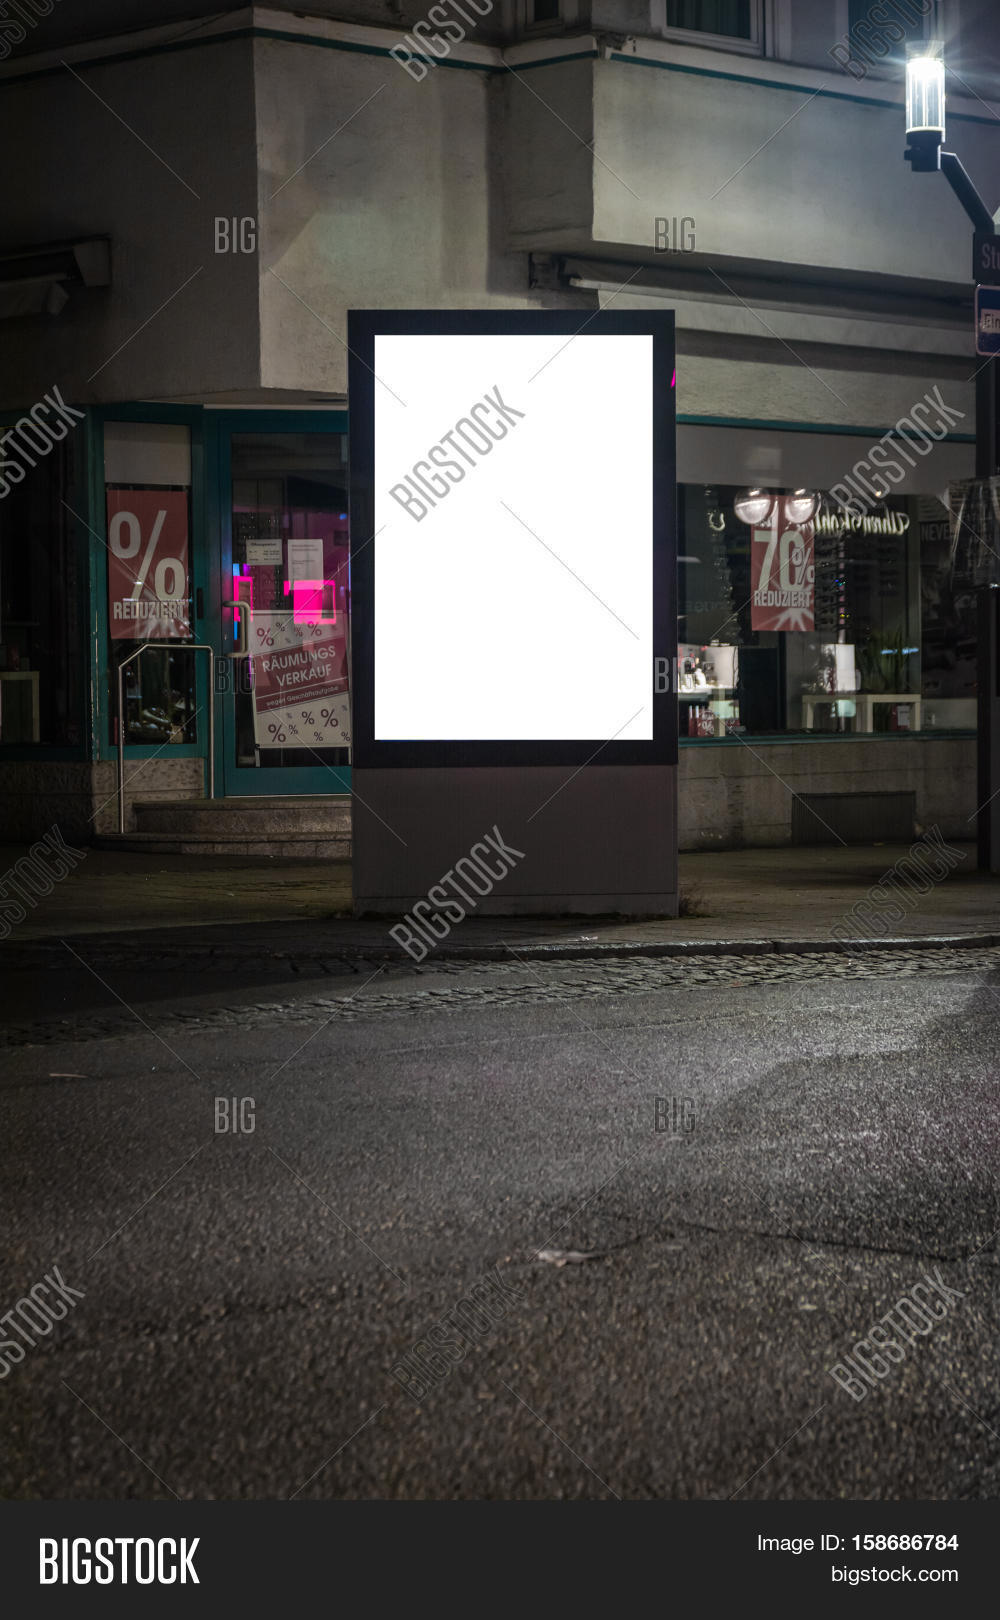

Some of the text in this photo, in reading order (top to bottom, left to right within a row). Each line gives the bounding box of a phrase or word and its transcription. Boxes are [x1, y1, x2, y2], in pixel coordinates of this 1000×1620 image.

[113, 599, 186, 620] REDUZIERT
[754, 590, 812, 609] REDUZIERT
[262, 645, 336, 673] RÄUMUNGS
[276, 663, 332, 687] VERKAUF
